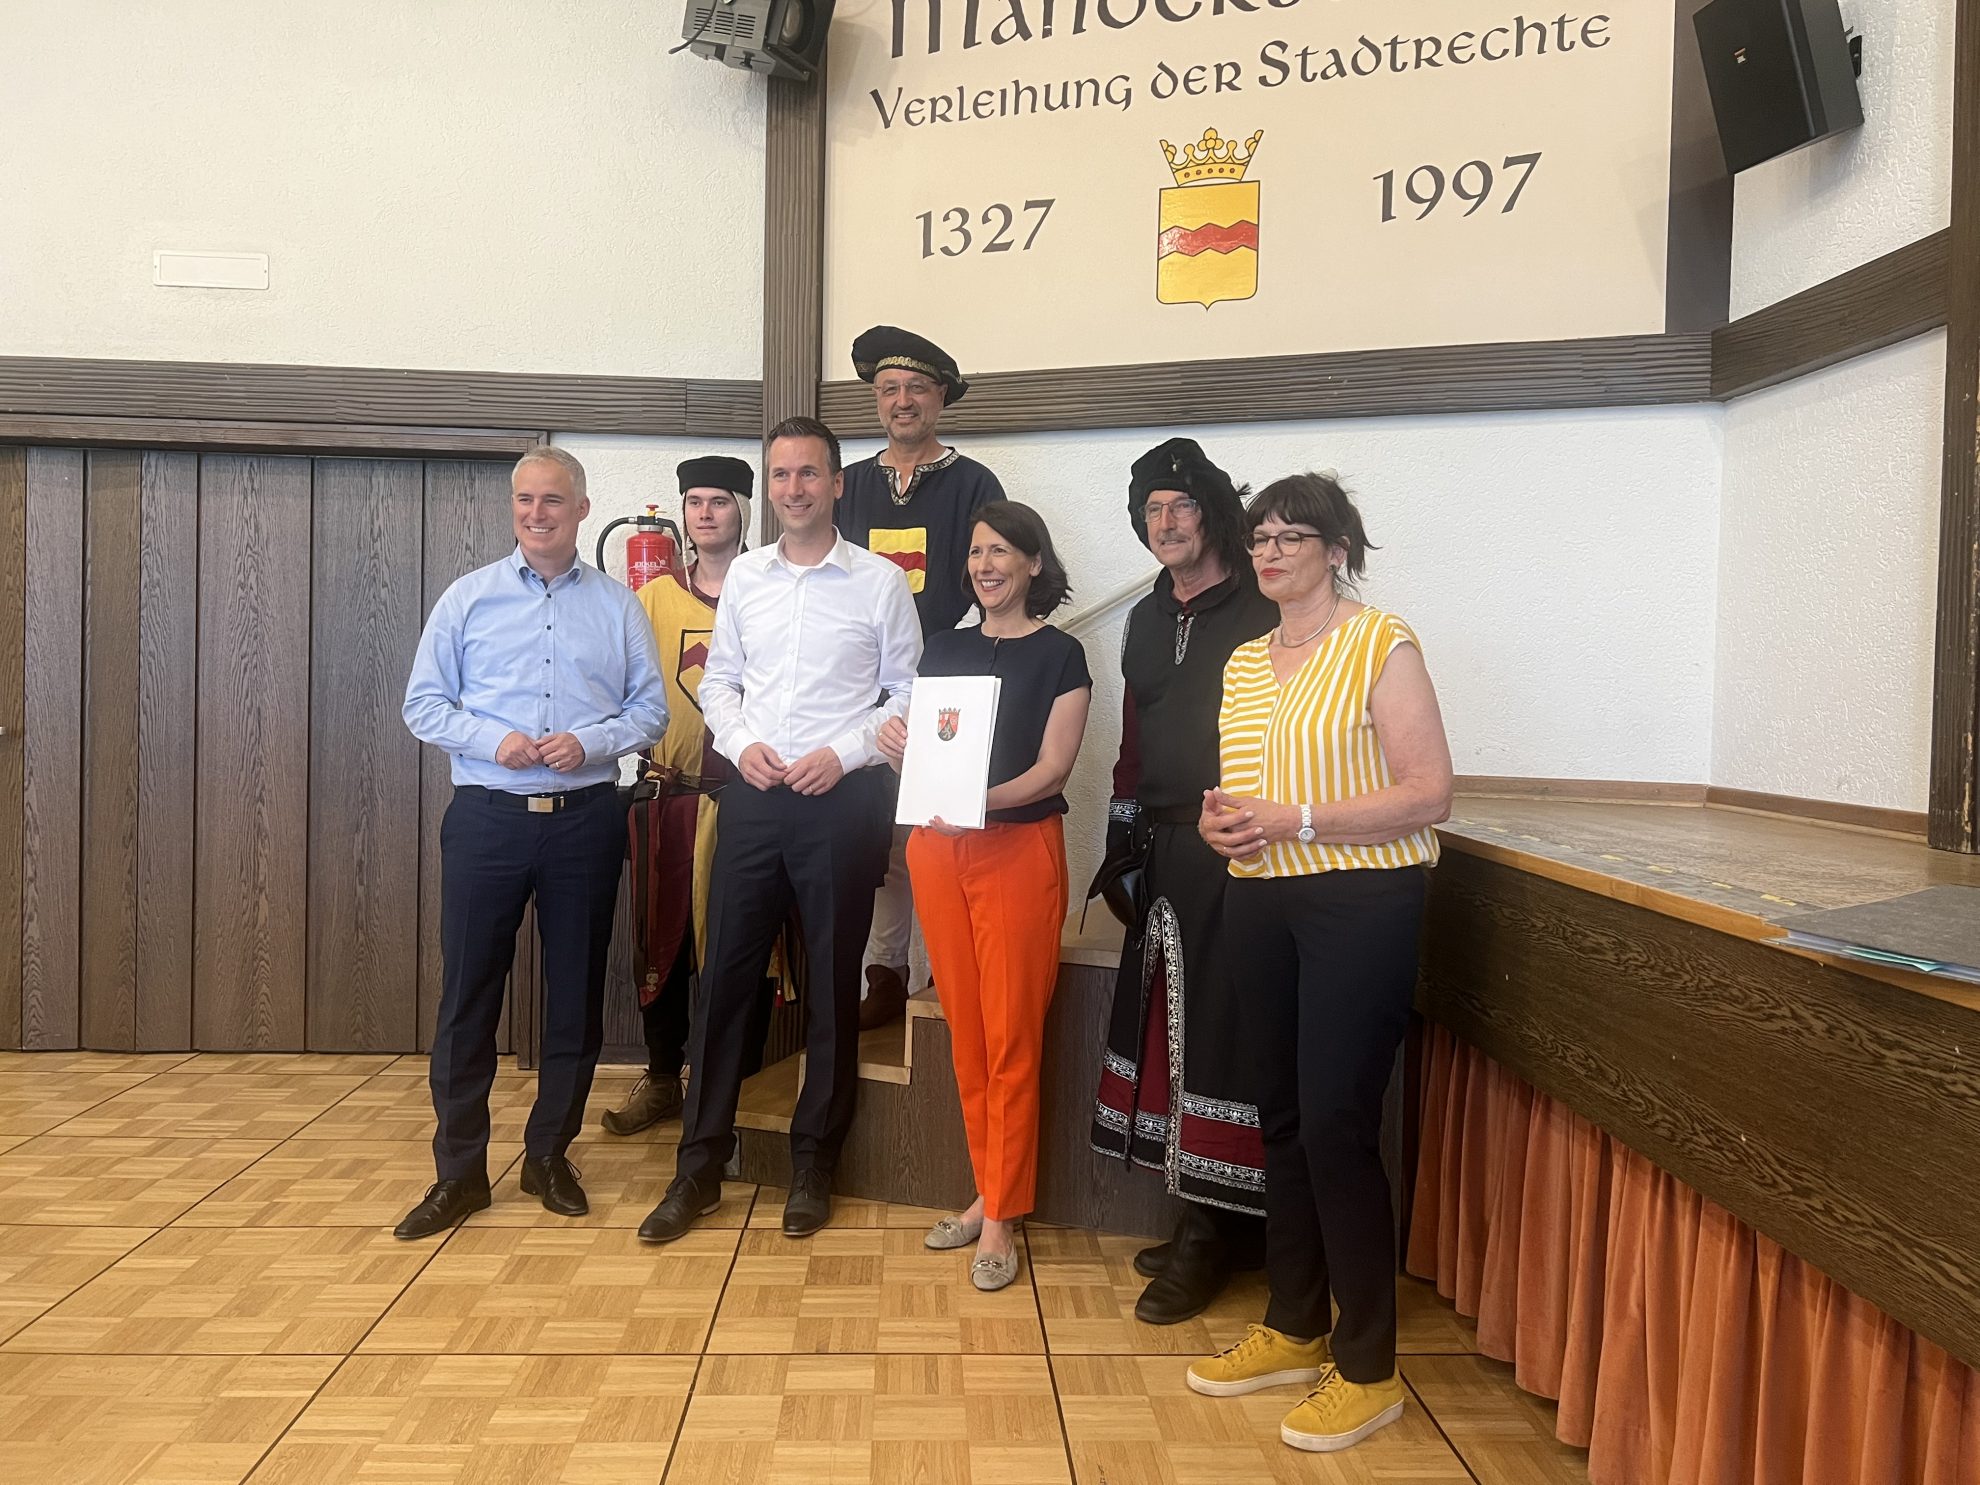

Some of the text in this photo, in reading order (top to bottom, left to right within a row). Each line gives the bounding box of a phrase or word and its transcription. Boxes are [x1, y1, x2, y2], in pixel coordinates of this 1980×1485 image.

[868, 73, 1133, 131] Verleihung
[1257, 12, 1612, 88] Stadtrechte
[1371, 151, 1544, 224] 1997
[914, 198, 1057, 260] 1327
